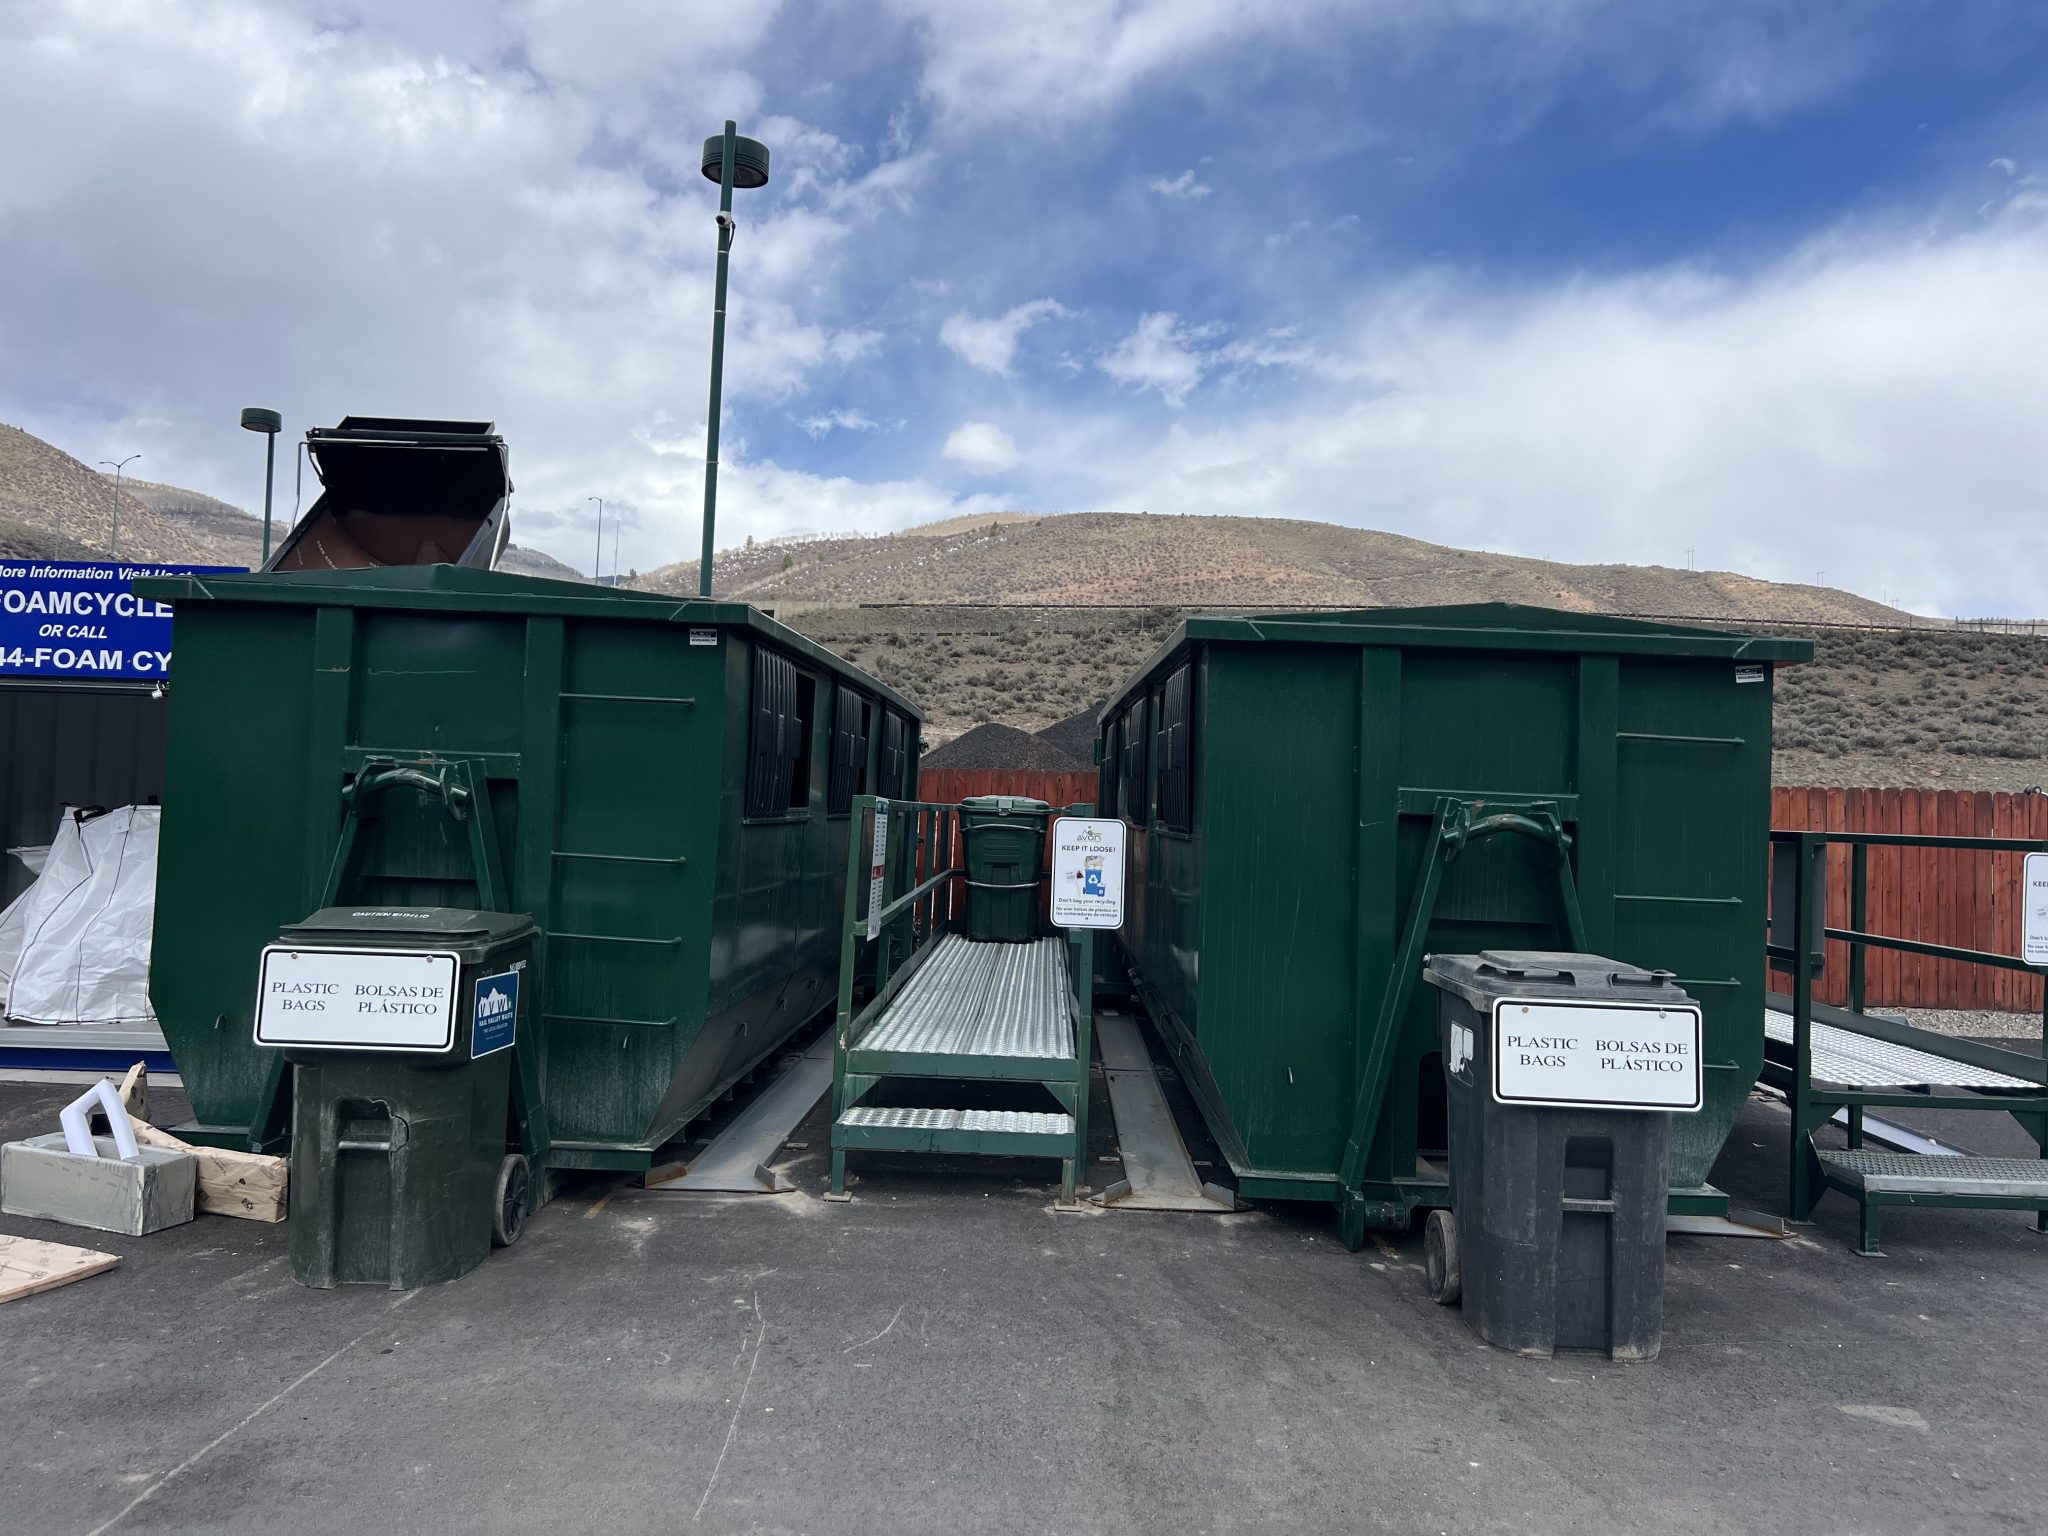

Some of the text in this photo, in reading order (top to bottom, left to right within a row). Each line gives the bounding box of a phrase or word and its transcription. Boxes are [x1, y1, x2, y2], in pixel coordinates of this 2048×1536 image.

[0, 565, 26, 578] ore
[29, 566, 113, 580] Information
[0, 589, 174, 618] OAMCYCLE
[39, 624, 108, 639] OR CALL
[1089, 845, 1116, 853] LOOSE!
[272, 981, 339, 995] PLASTIC
[355, 984, 444, 998] BOLSAS DE
[282, 999, 326, 1011] BAGS
[358, 999, 438, 1015] PLÁSTICO
[1507, 1035, 1578, 1050] PLASTIC
[1596, 1039, 1688, 1055] BOLSAS DE
[1519, 1054, 1566, 1068] BAGS
[1600, 1054, 1683, 1073] PLÁSTICO
